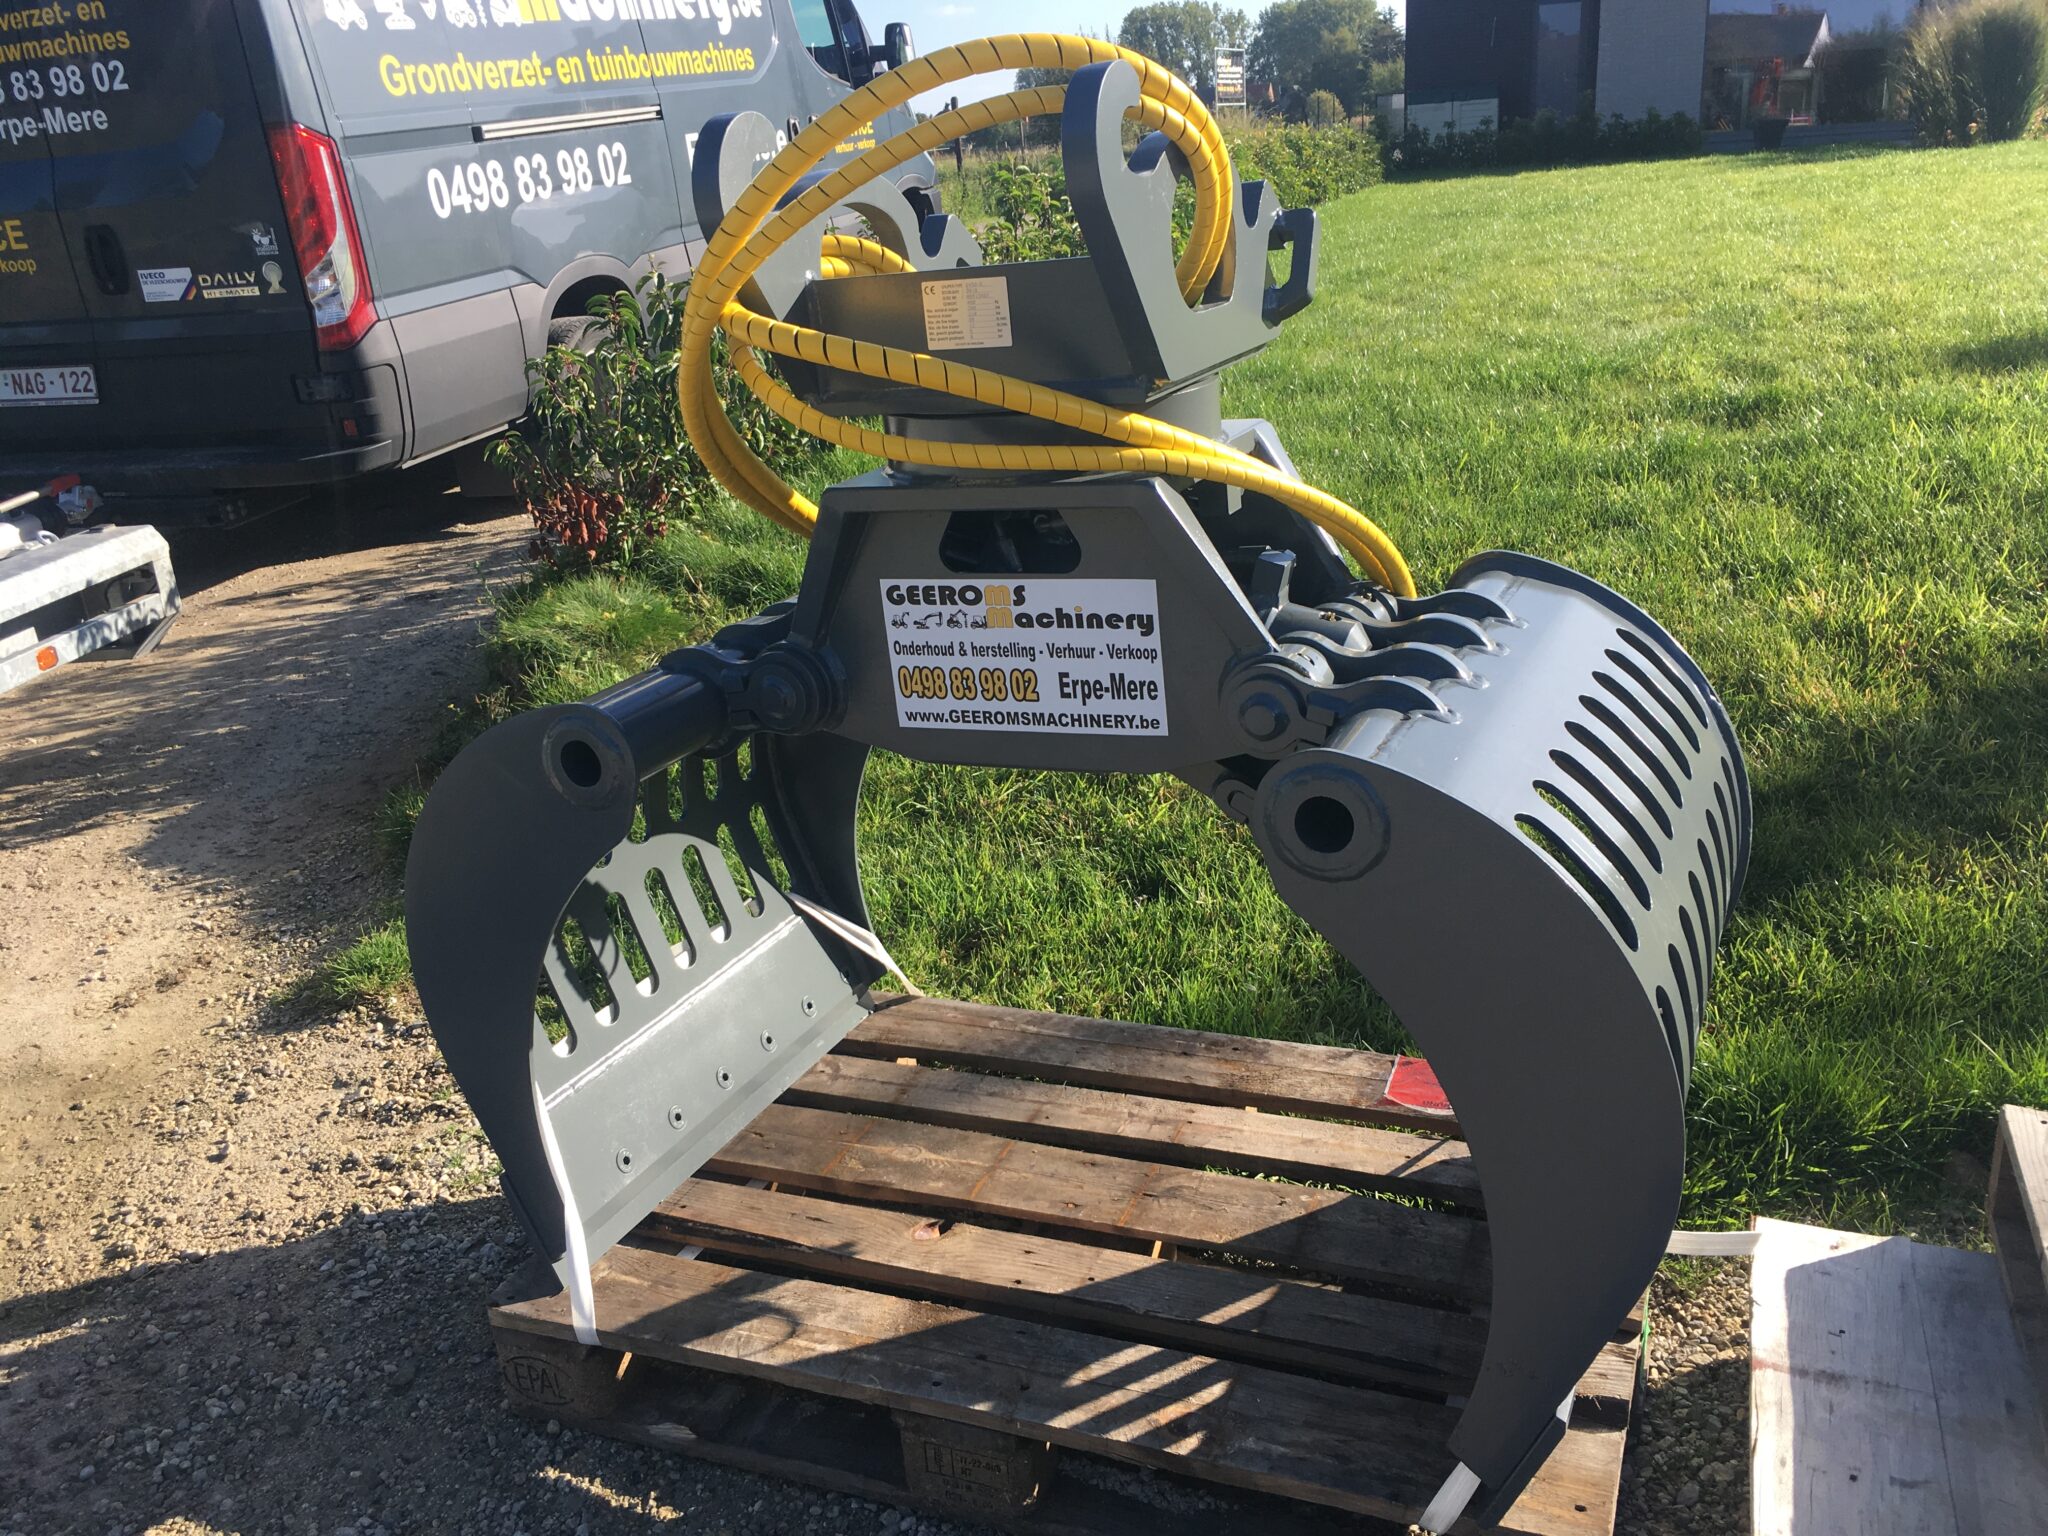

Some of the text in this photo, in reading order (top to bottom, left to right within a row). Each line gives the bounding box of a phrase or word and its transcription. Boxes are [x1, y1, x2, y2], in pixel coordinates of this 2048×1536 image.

[76, 0, 106, 21] en
[10, 69, 44, 101] 83
[49, 64, 85, 97] 98
[91, 60, 130, 93] 02
[379, 41, 755, 97] Grondverzet- en tuinbouwmachines
[427, 159, 509, 219] 0498
[513, 153, 553, 203] 83
[556, 147, 593, 195] 98
[597, 141, 632, 188] 02
[140, 271, 166, 280] IVECO
[198, 270, 256, 287] DAILY
[893, 640, 955, 657] Onderhoud
[958, 641, 968, 656] &
[971, 641, 1036, 663] herstelling
[1046, 642, 1096, 659] Verhuur
[1106, 643, 1158, 664] Verkoop
[898, 665, 1159, 706] 0498 83 98 02 Erpe-Mere
[905, 709, 1161, 730] www.GEEROMSMACHINERY.be
[513, 1361, 567, 1400] EPAL
